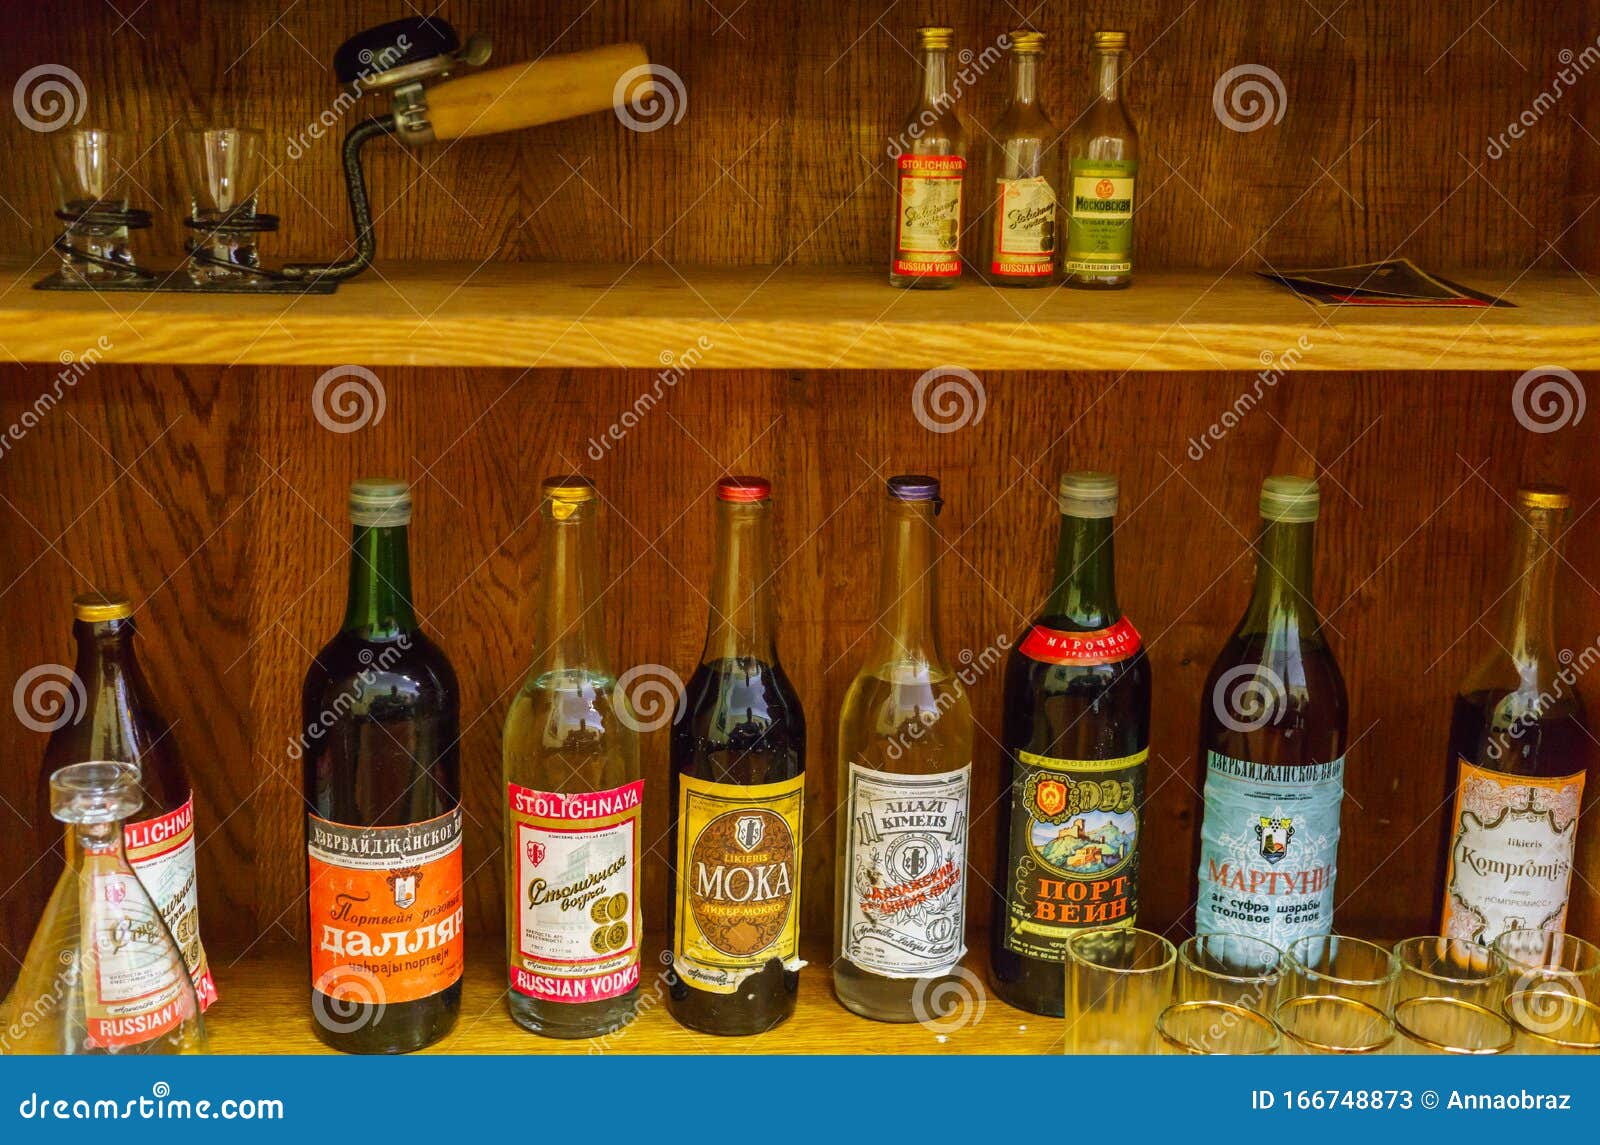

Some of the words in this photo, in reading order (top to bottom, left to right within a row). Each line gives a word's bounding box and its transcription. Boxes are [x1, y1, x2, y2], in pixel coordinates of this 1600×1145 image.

[902, 160, 963, 170] STOLICHNAYA
[898, 261, 933, 272] RUSSIAN
[934, 262, 958, 272] VODKA
[1000, 262, 1036, 273] RUSSIAN
[1046, 631, 1125, 650] МАРОЧНОЕ
[515, 788, 638, 819] STOLICHNAYA
[314, 822, 453, 856] АЗЕРБАЙДЖАНСКОЕ
[528, 854, 627, 910] Столичная
[695, 862, 792, 902] MOKA
[1207, 857, 1331, 896] МАРТУНИ
[330, 892, 413, 927] Портвейн
[560, 884, 607, 912] водка
[1034, 897, 1128, 923] ВЕЙН
[1211, 903, 1271, 924] столовое
[1284, 911, 1320, 925] белое
[518, 970, 587, 997] RUSSIAN
[590, 965, 638, 994] VODKA
[100, 1003, 172, 1038] RUSSIAN
